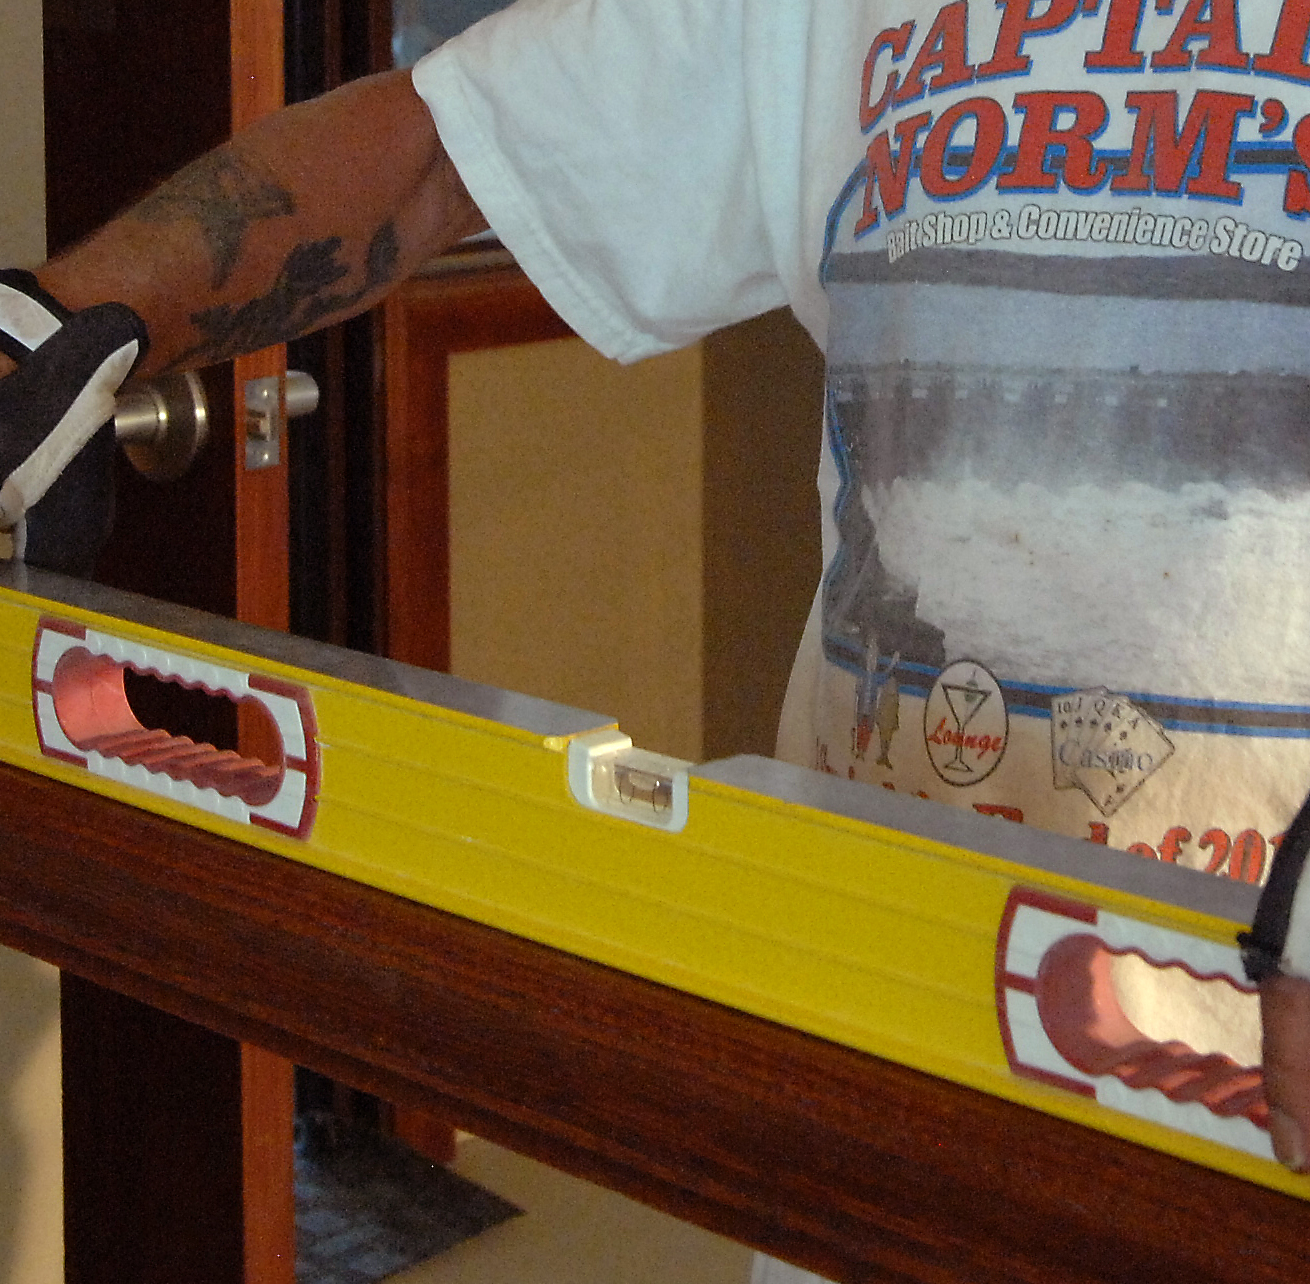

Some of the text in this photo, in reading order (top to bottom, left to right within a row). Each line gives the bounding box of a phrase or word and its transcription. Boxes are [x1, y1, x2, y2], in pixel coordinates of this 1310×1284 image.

[887, 203, 1304, 273] Bait Shop & Convenience Store
[926, 717, 1003, 760] Lounge
